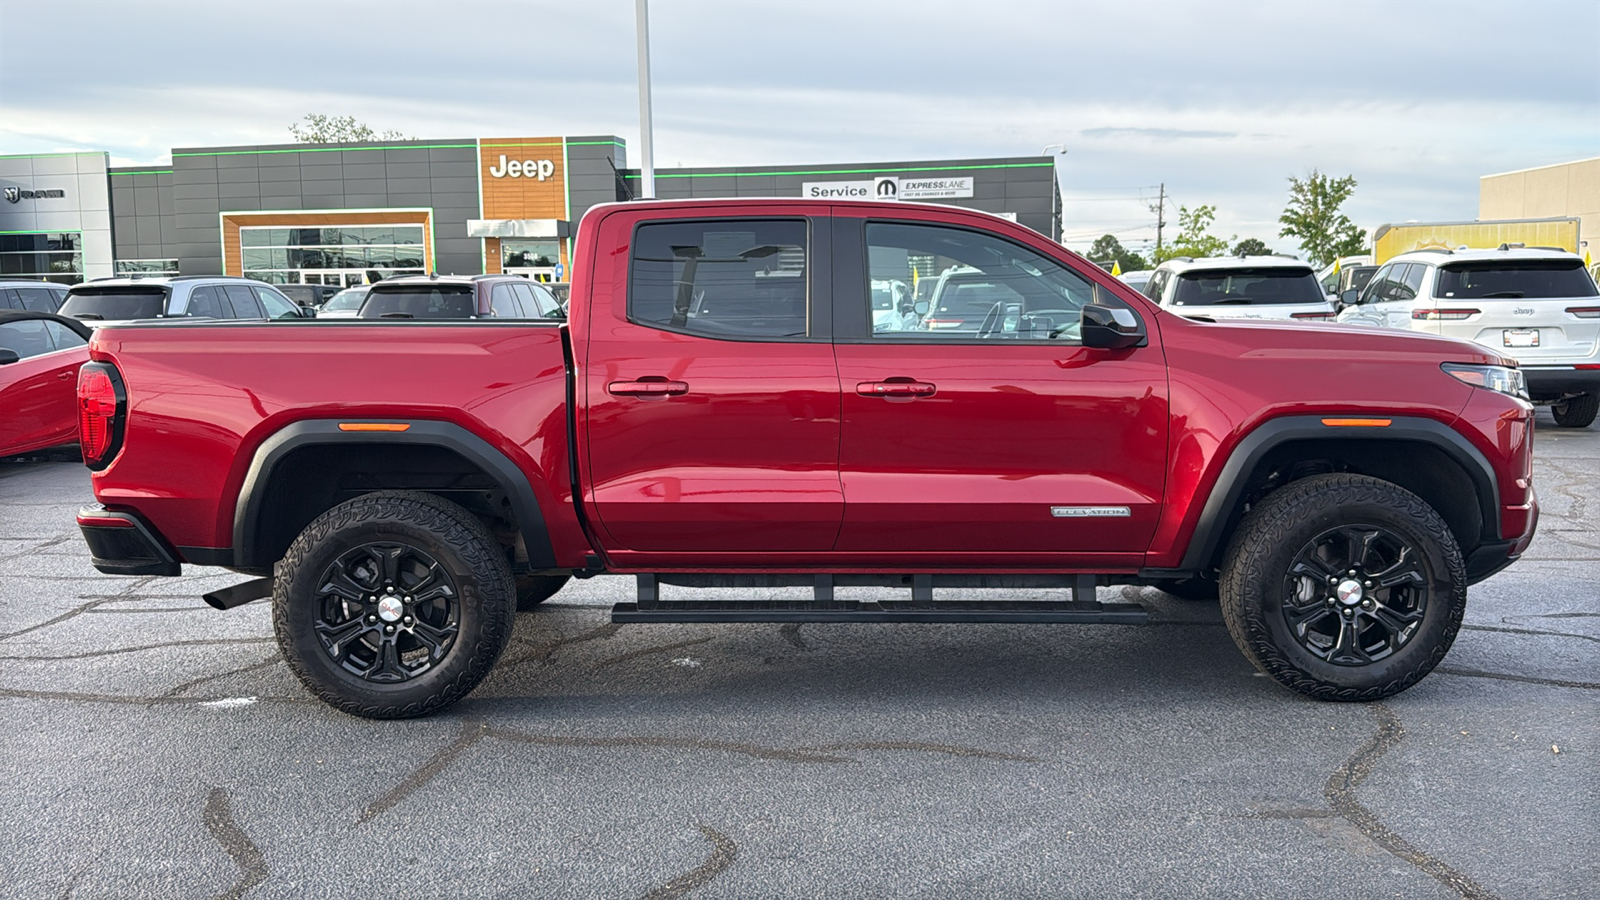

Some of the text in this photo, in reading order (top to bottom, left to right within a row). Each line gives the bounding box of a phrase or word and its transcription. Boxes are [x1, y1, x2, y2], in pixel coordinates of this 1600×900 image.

[489, 154, 554, 181] Jeep
[20, 189, 65, 200] RAM
[811, 186, 867, 197] Service
[1513, 307, 1535, 316] Jeep
[1341, 585, 1360, 601] GMC
[381, 602, 400, 618] GMC
